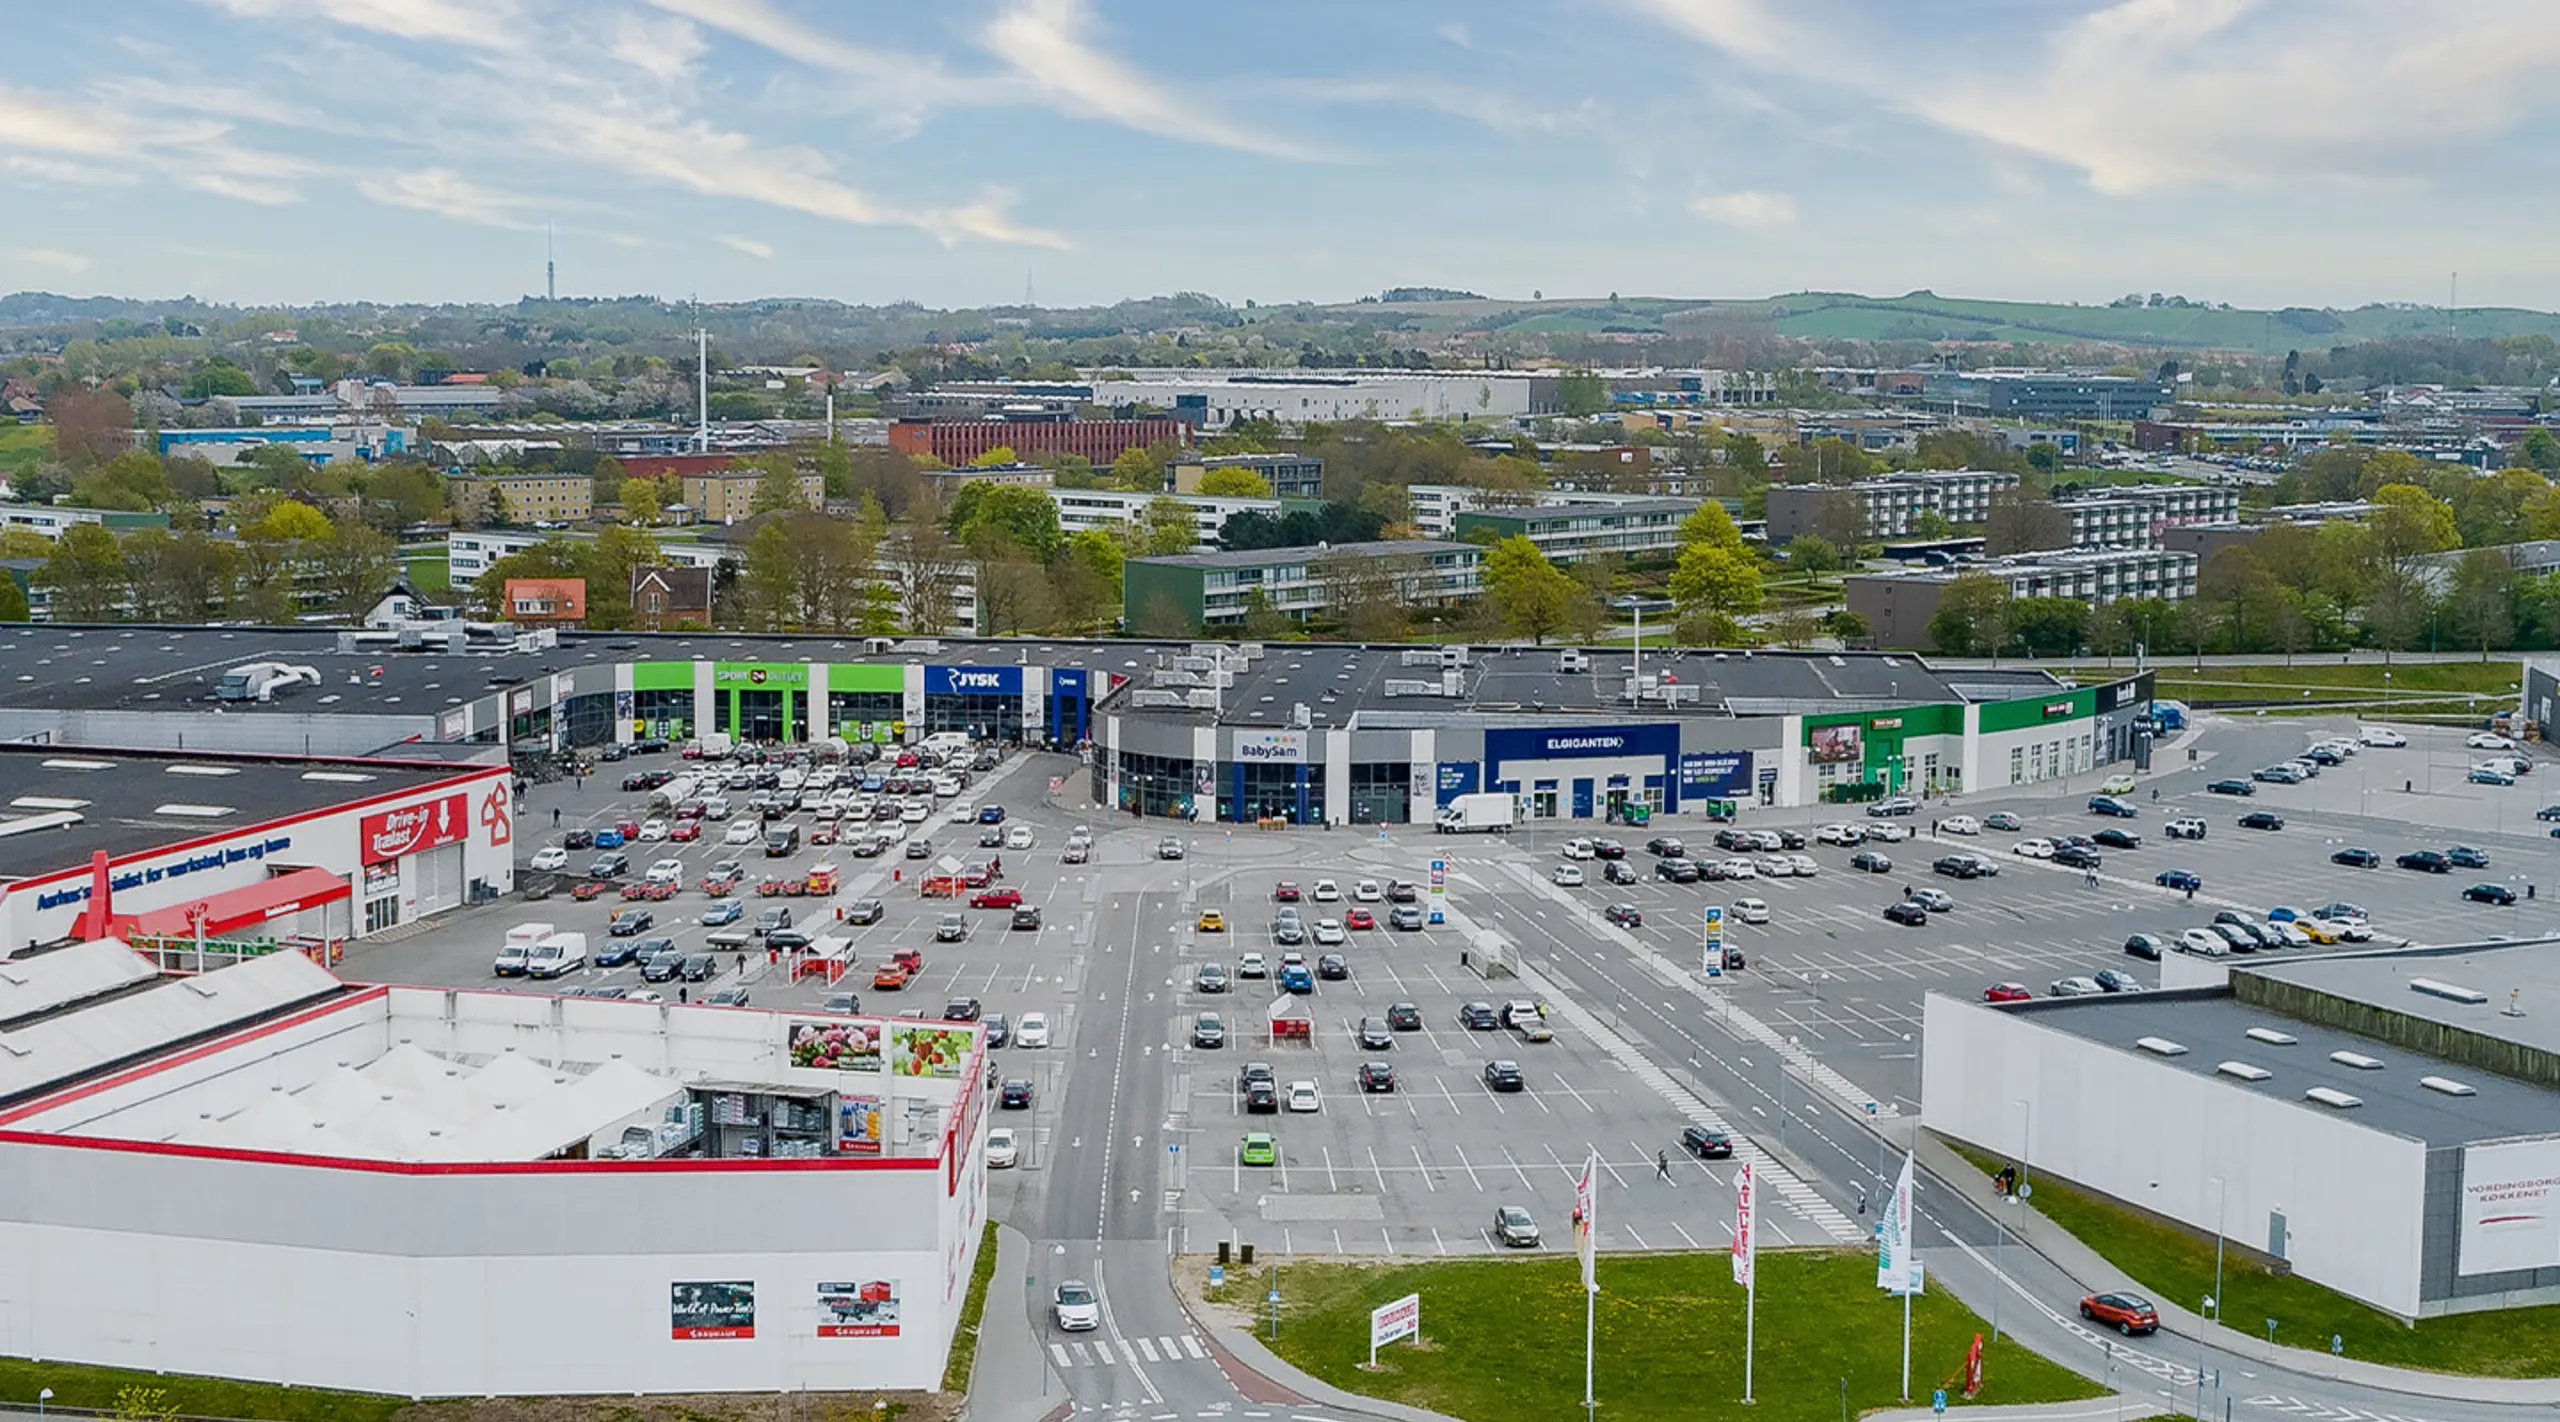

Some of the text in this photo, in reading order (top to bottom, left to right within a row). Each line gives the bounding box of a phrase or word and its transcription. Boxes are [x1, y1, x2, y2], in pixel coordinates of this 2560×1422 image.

[958, 672, 1000, 687] JYSK
[1547, 737, 1620, 750] ELGIGANTEN
[1242, 745, 1298, 759] BabySam
[385, 805, 431, 832] Drive-in
[372, 828, 412, 852] Trælast
[145, 867, 165, 884] for
[248, 843, 264, 859] og
[2479, 1188, 2549, 1203] KØKKENET
[673, 1302, 697, 1315] World
[710, 1302, 733, 1314] Power
